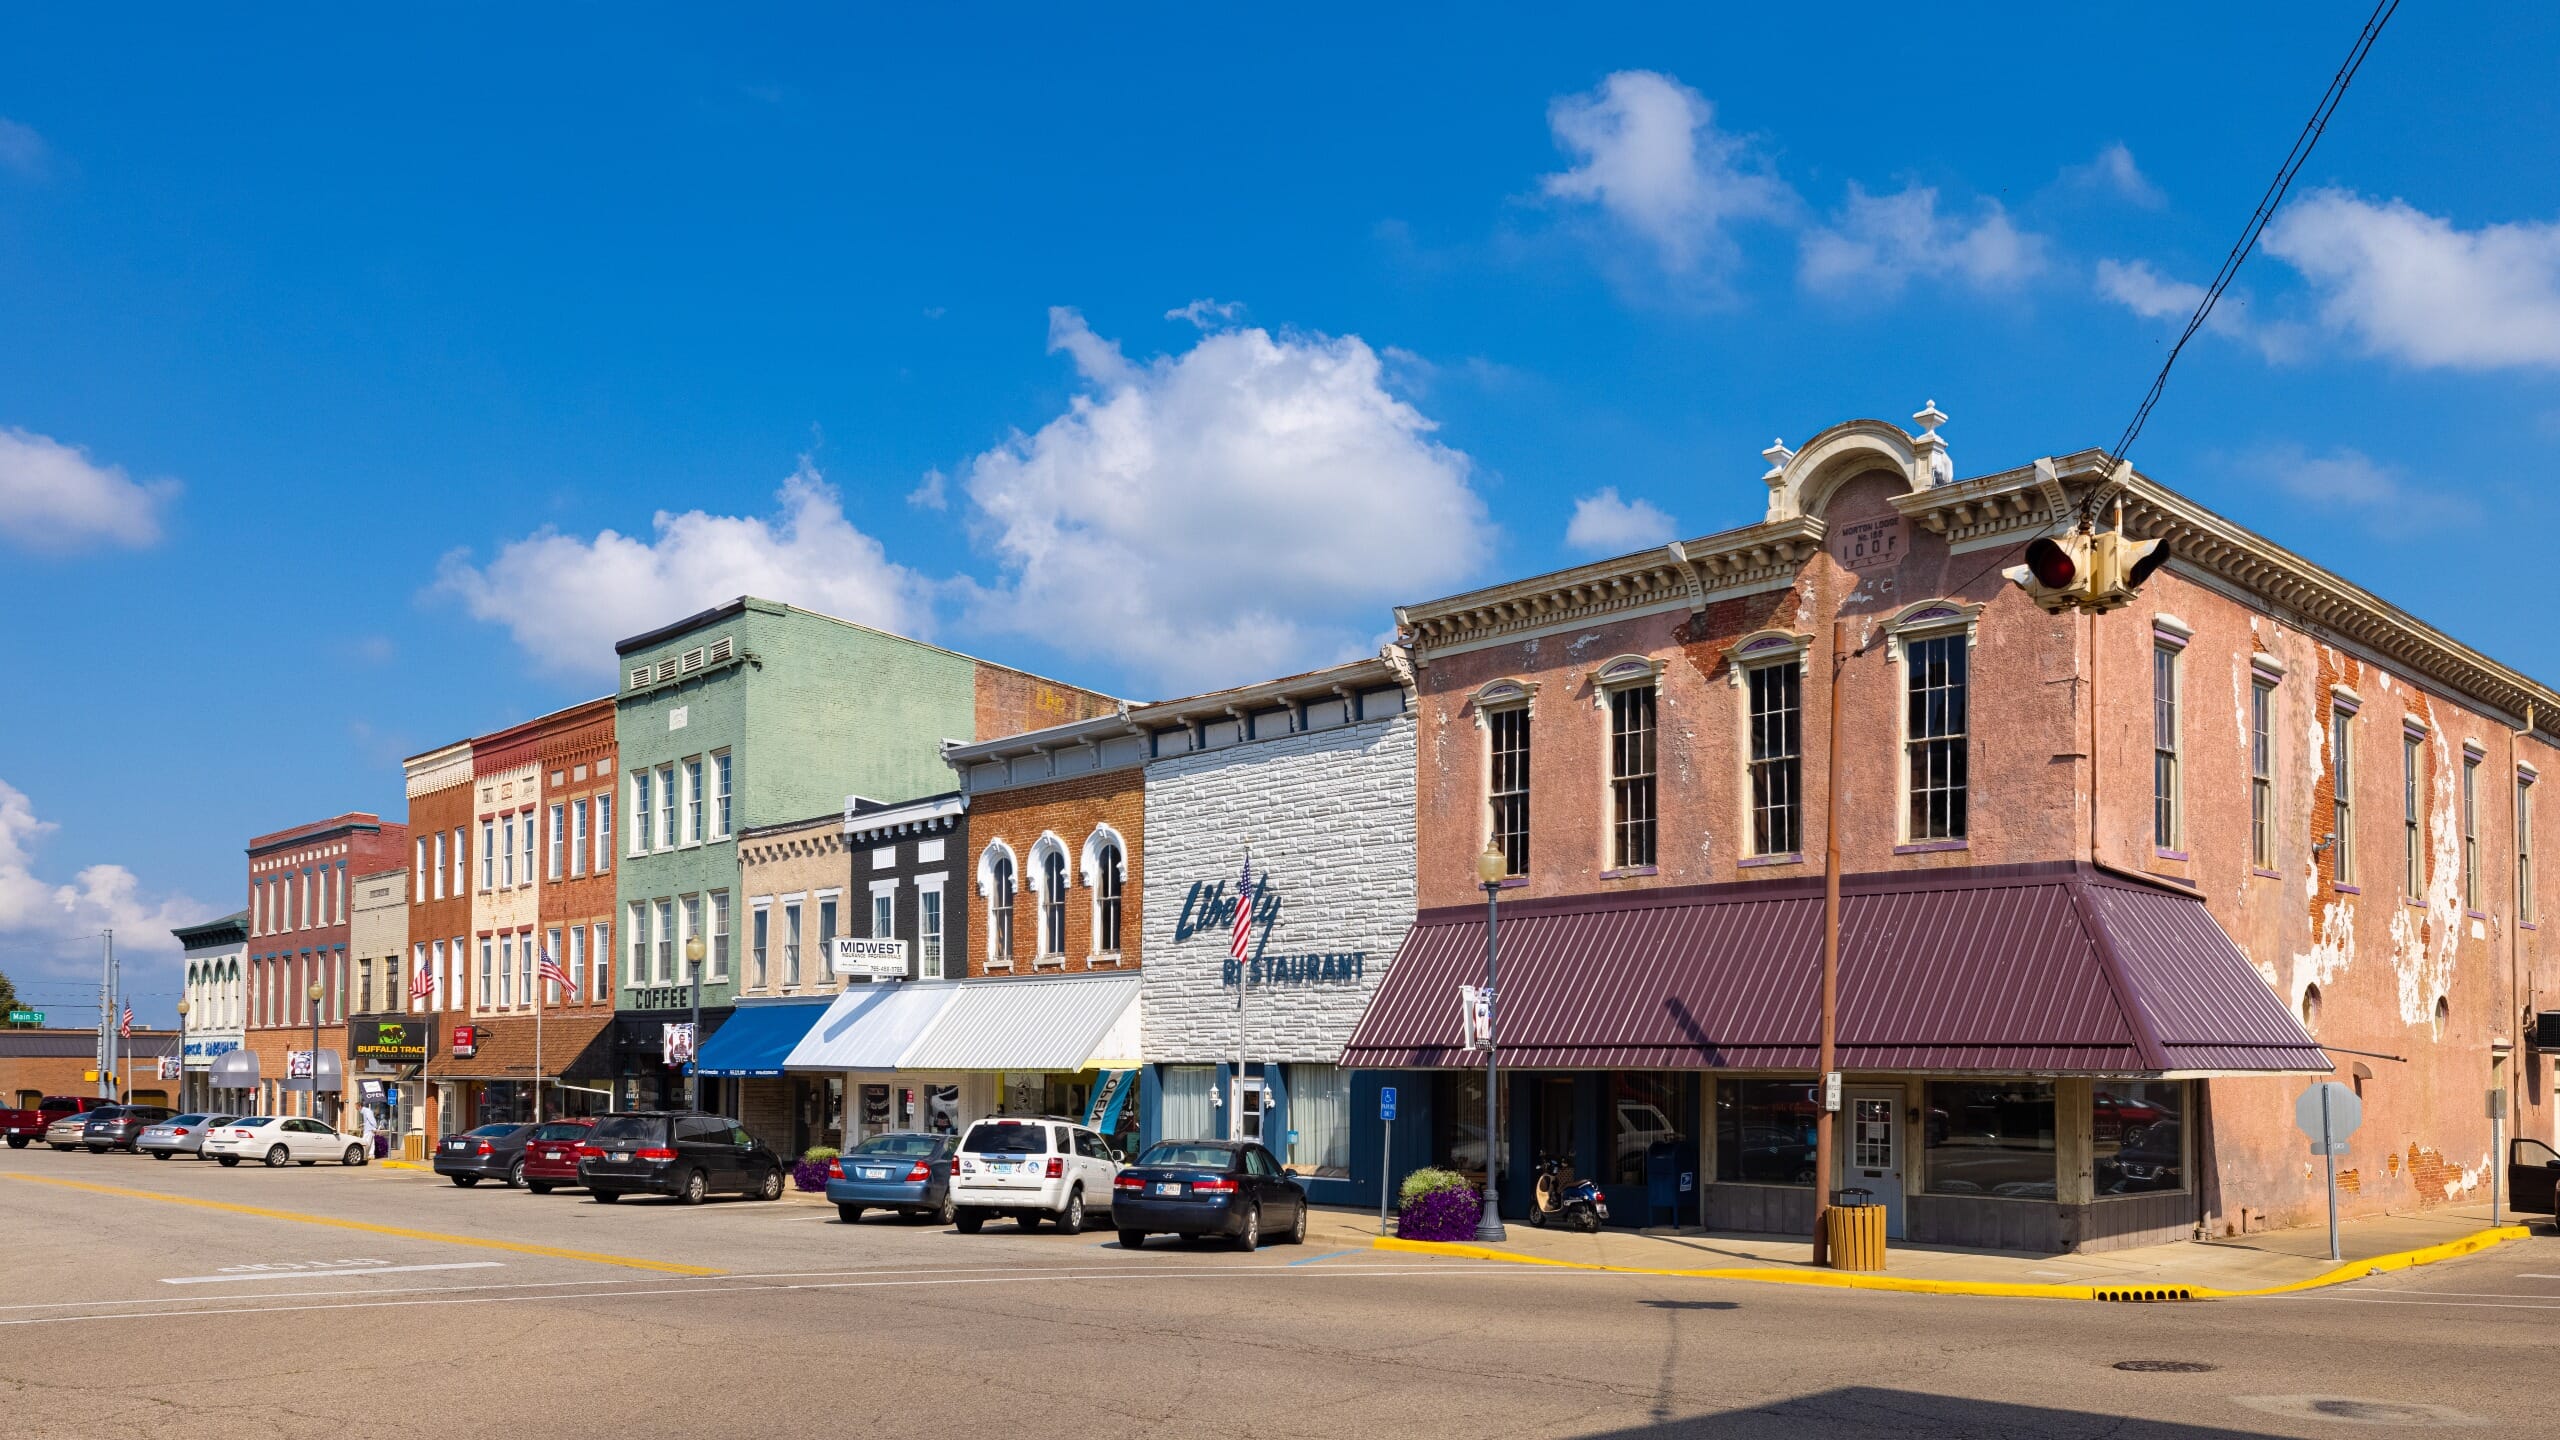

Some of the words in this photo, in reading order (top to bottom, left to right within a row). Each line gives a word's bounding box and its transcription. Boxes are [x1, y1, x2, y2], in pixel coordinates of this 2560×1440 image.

[1842, 523, 1873, 536] MORTON
[1874, 517, 1899, 530] LODGE
[1175, 872, 1282, 957] Libety
[840, 942, 902, 955] MIDWEST
[636, 988, 687, 1009] COFFEE
[357, 1045, 398, 1053] BUFFALO
